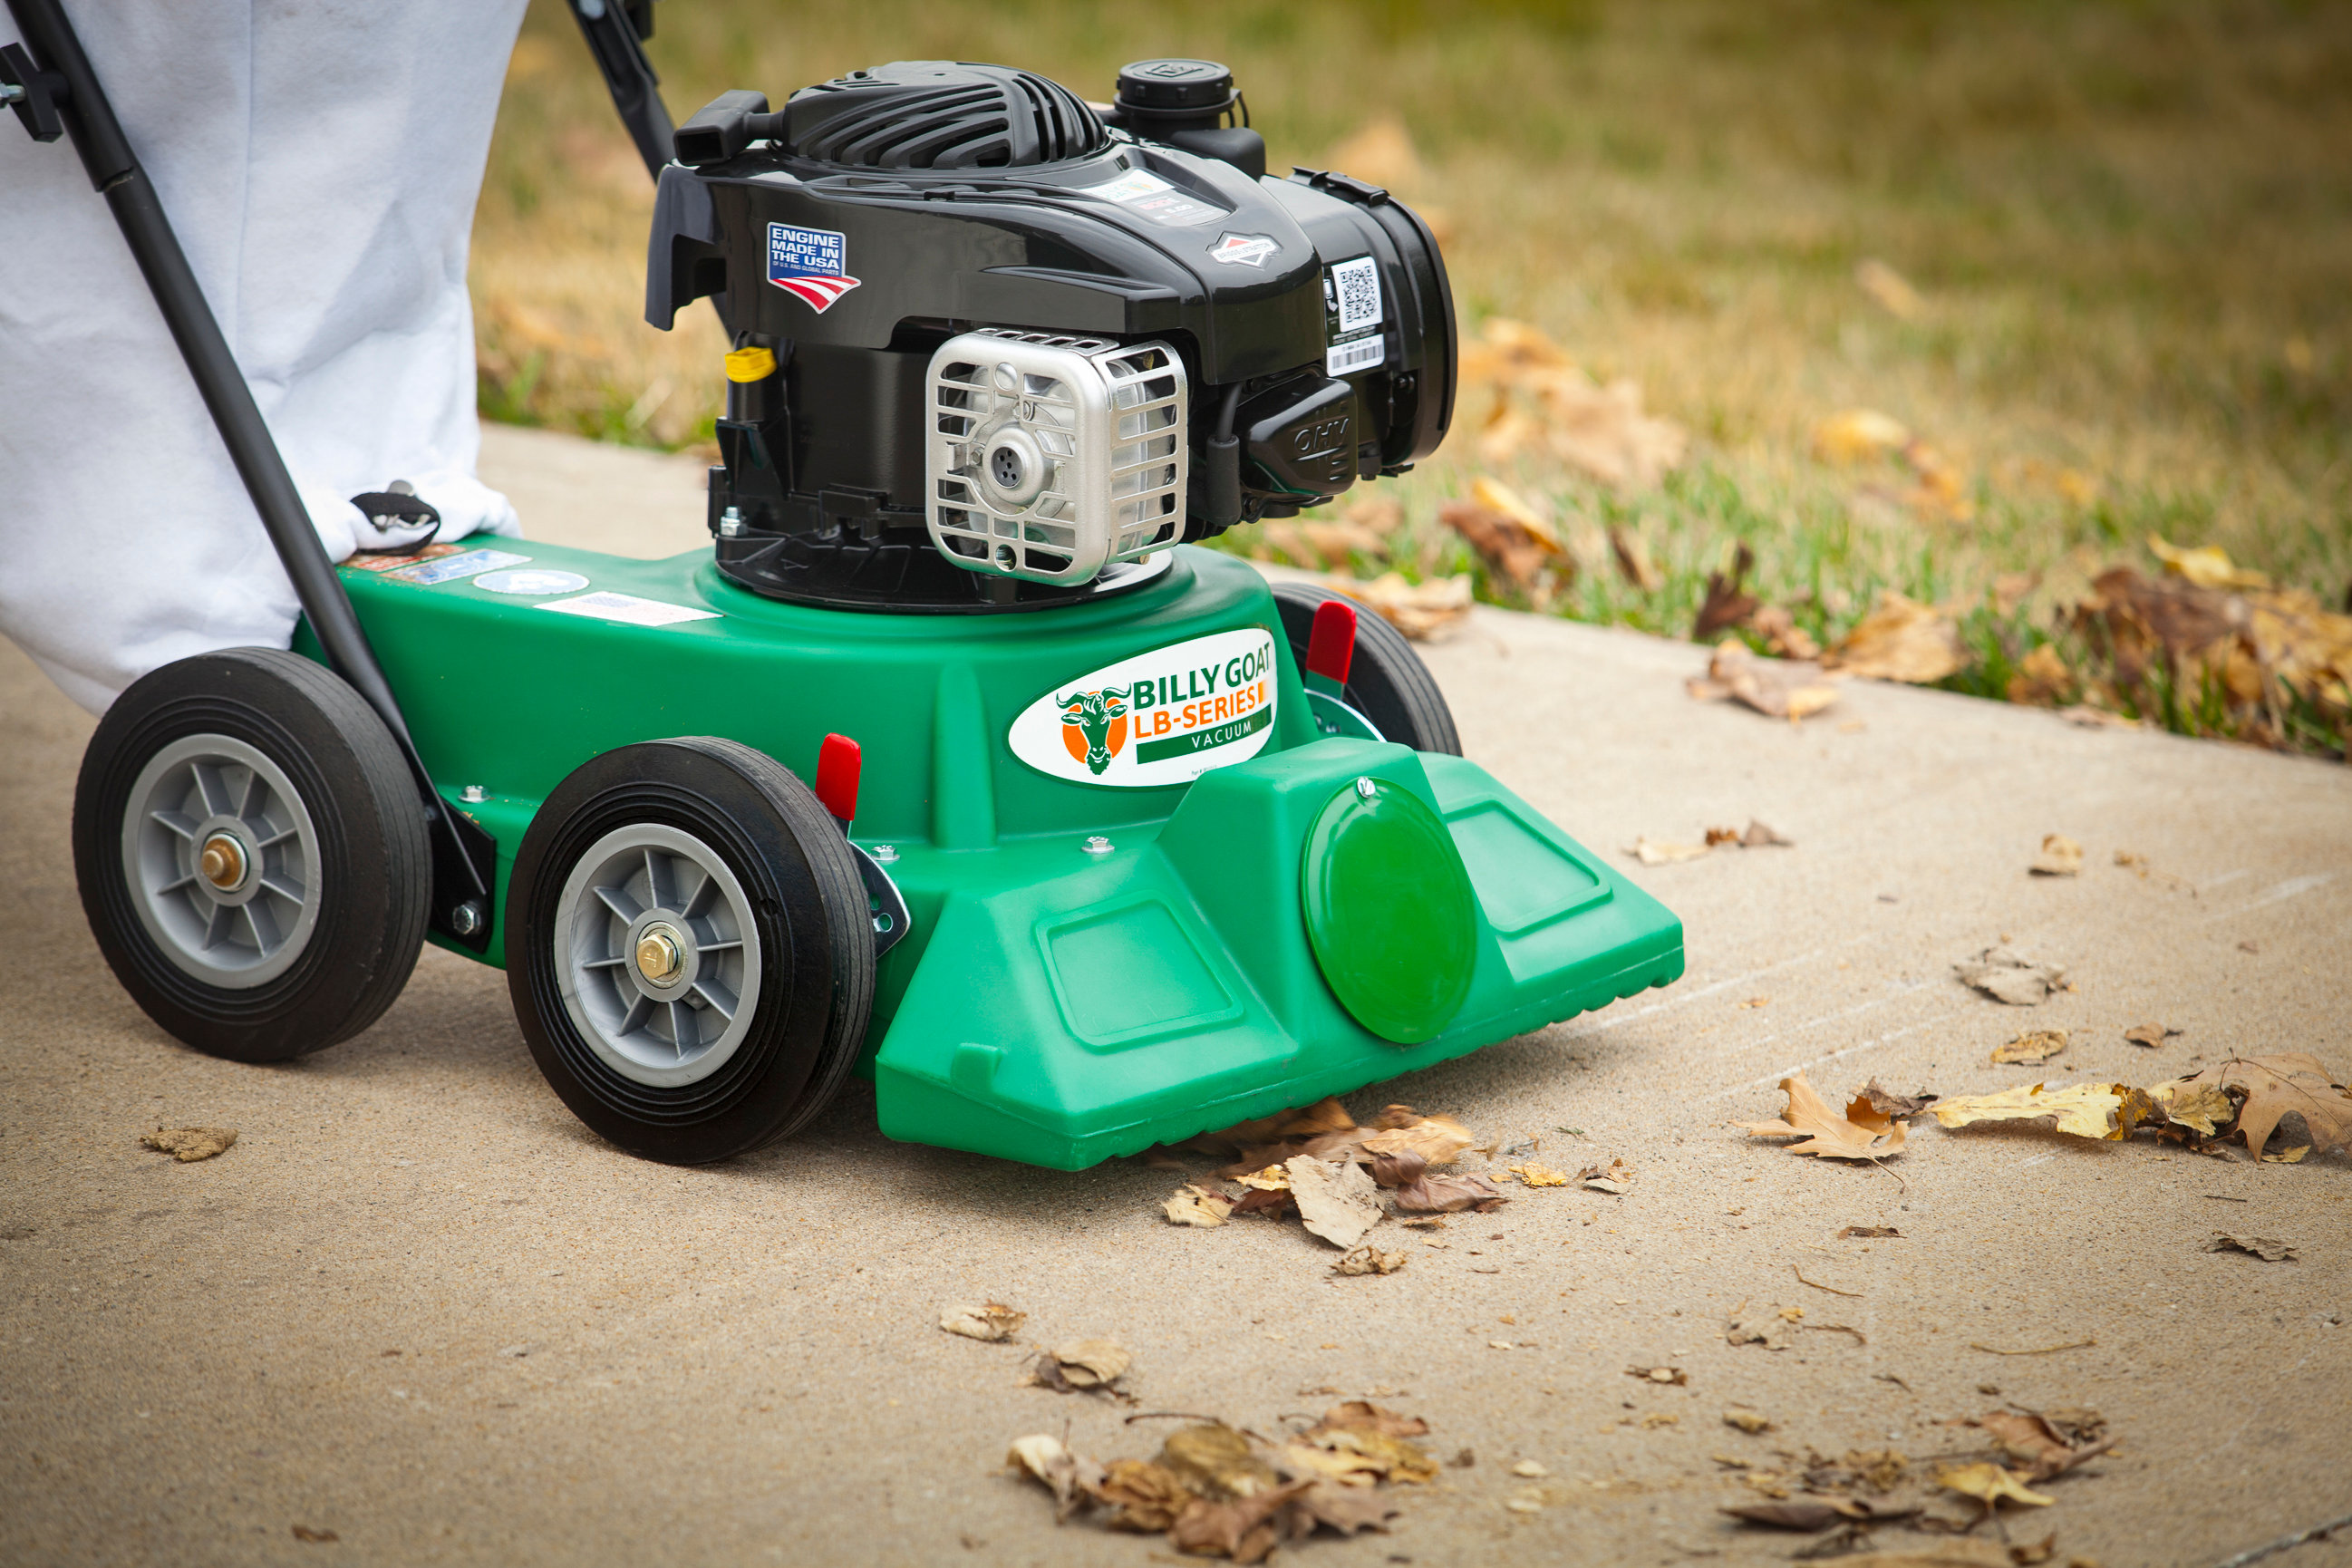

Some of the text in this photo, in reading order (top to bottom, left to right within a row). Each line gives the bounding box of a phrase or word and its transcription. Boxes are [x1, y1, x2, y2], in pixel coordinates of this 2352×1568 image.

[772, 227, 839, 248] ENGINE
[771, 239, 839, 259] MADE IN
[771, 250, 840, 270] THE USA
[801, 266, 821, 274] GLOBAL
[1133, 642, 1270, 711] BILLY GOAT
[1134, 685, 1255, 739] LB-SERIES
[1192, 720, 1252, 749] VACUUM
